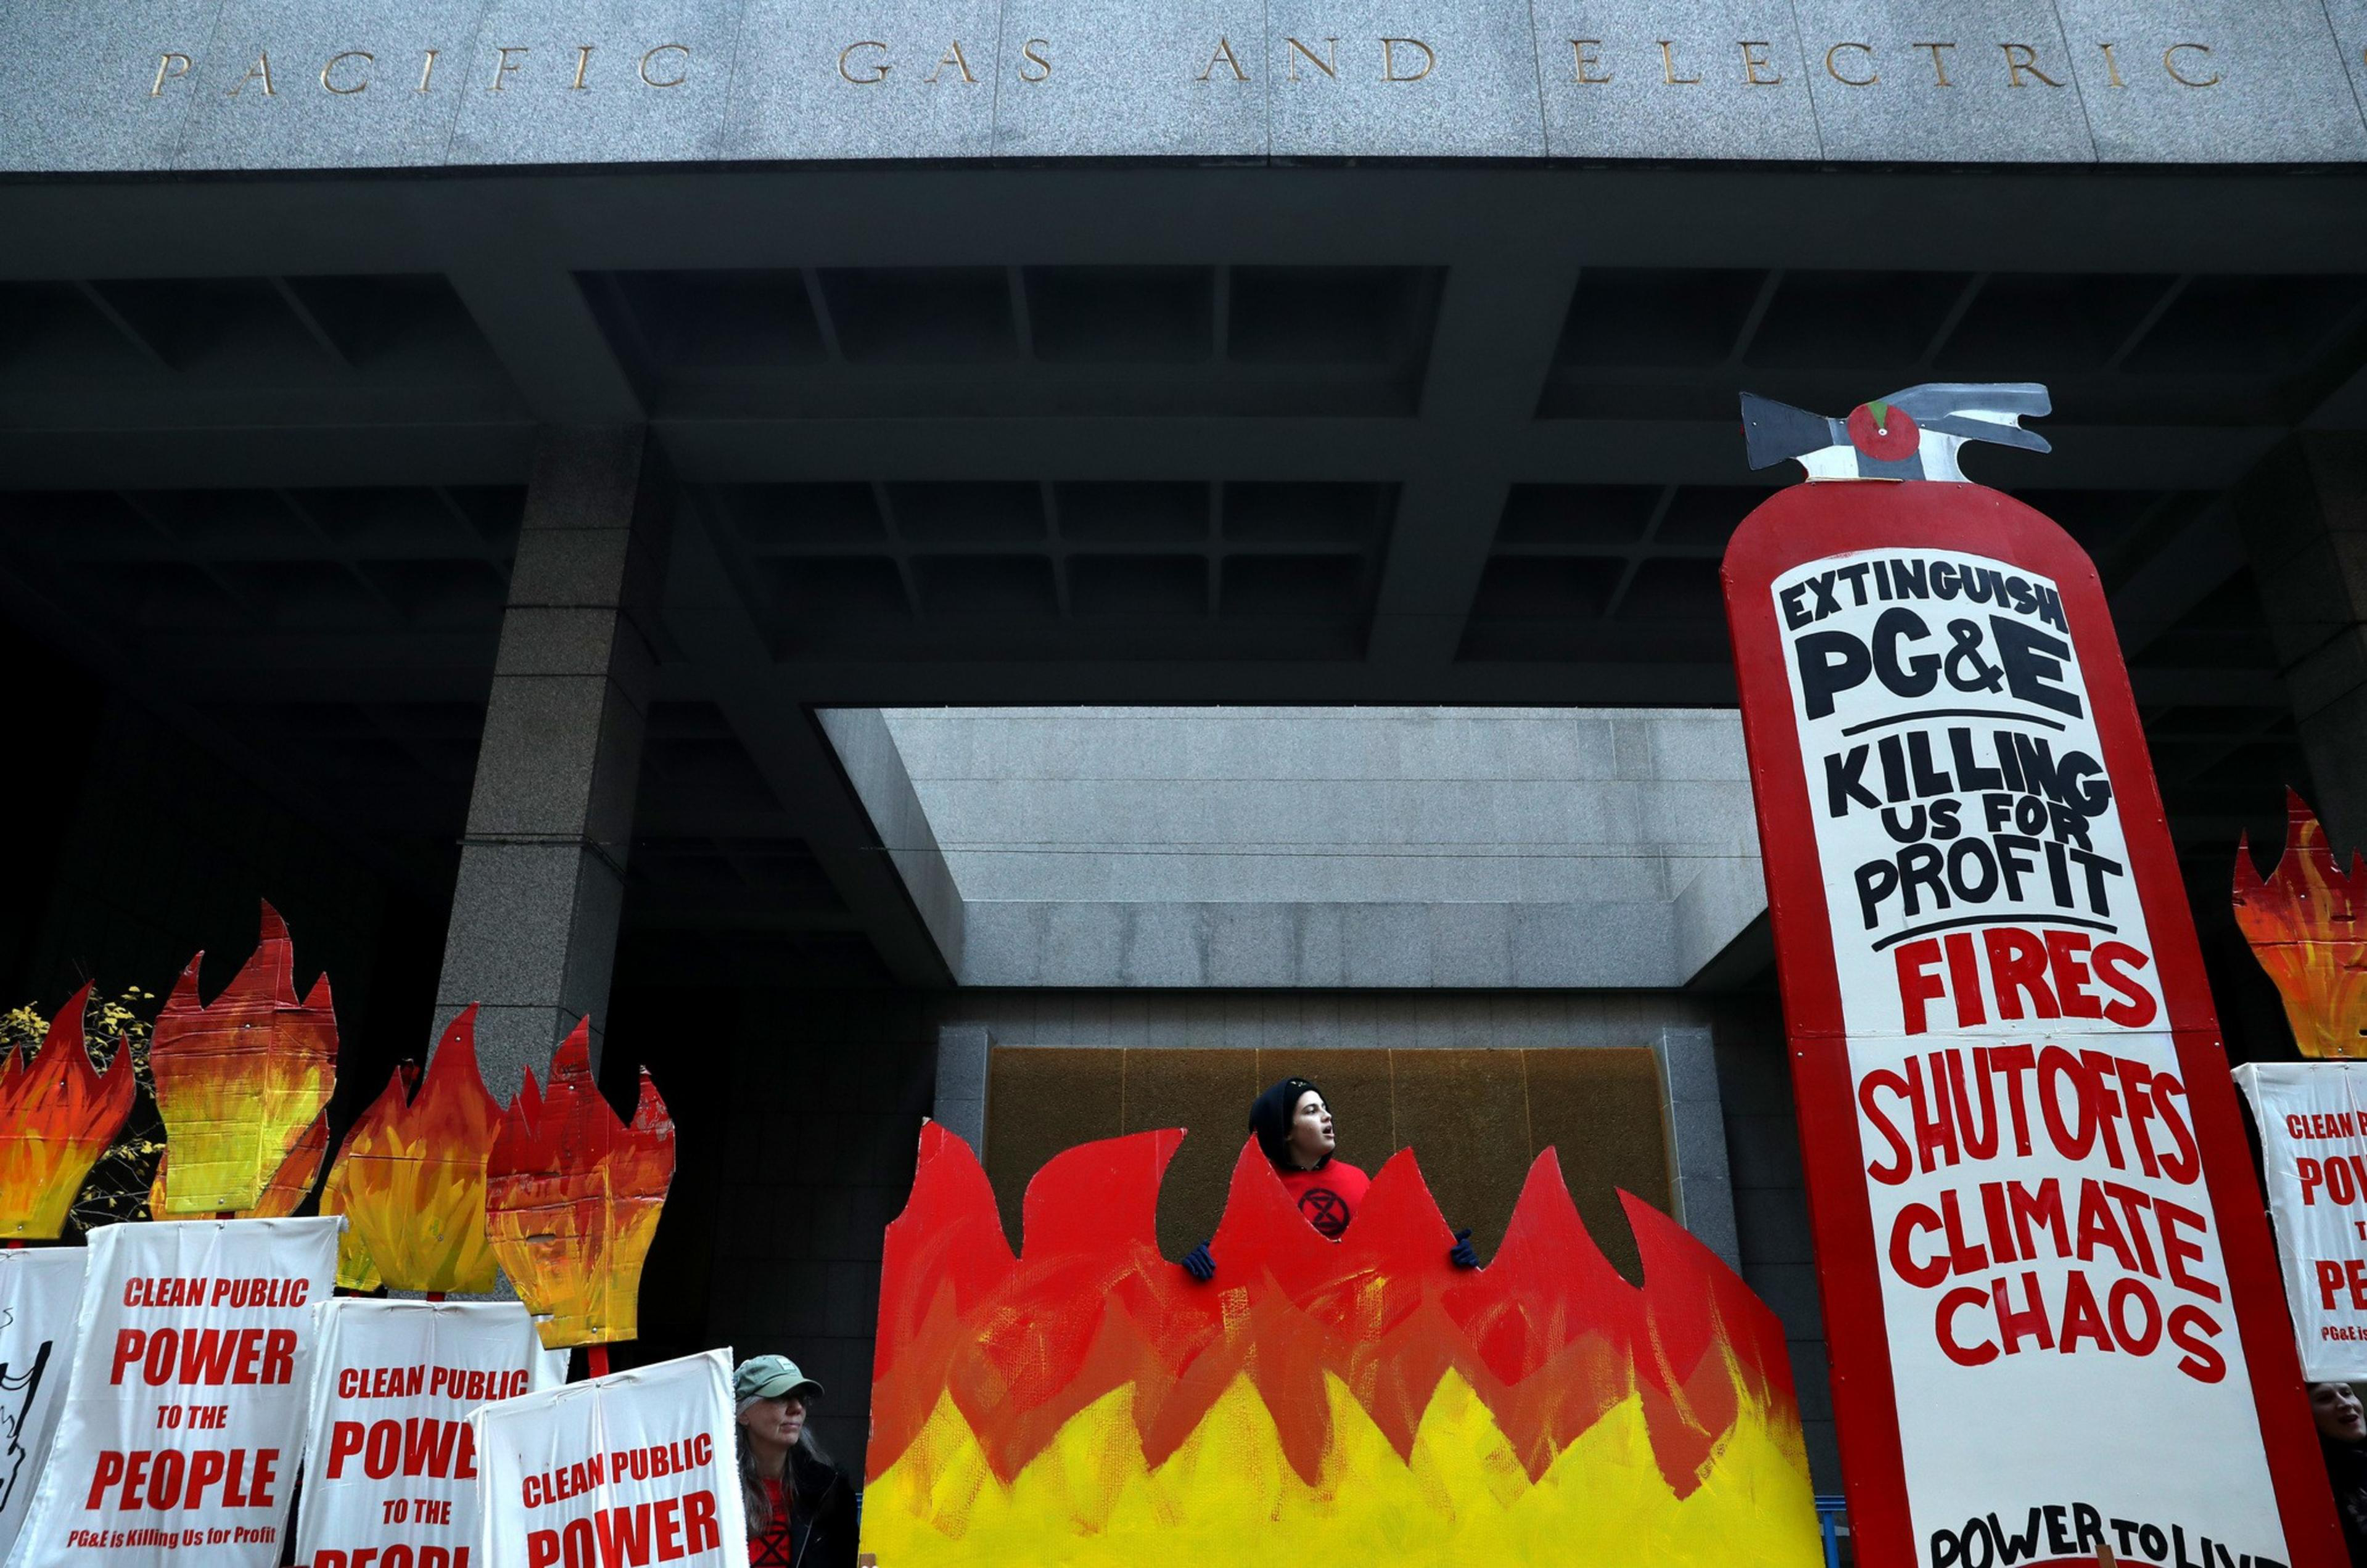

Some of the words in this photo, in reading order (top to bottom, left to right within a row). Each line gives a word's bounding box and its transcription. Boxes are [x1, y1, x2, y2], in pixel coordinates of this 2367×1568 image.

[148, 43, 690, 96] PACIFIC
[837, 38, 1052, 83] GAS
[1195, 37, 1437, 81] AND
[1570, 39, 2220, 88] ELECTRIC
[1779, 559, 2070, 635] EXTINGUISH
[1794, 607, 2083, 720] PG&E
[1823, 727, 2113, 818] KILLING
[1880, 798, 1962, 844] US
[1982, 793, 2093, 853] FOR
[1854, 834, 2124, 930] PROFIT
[1893, 927, 2158, 1036] FIRES
[1858, 1044, 2200, 1186] SHUTOFFS
[2286, 1112, 2355, 1139] CLEAN
[1888, 1178, 2223, 1303] CLIMATE
[123, 1277, 208, 1308] CLEAN
[210, 1278, 310, 1309] PUBLIC
[110, 1328, 298, 1387] POWER
[1935, 1270, 2227, 1384] CHAOS
[2323, 1326, 2355, 1340] PG&E
[338, 1364, 425, 1400] CLEAN
[429, 1366, 529, 1401] PUBLIC
[157, 1404, 183, 1430] TO
[187, 1405, 228, 1430] THE
[86, 1449, 280, 1512] PEOPLE
[522, 1452, 605, 1510] CLEAN
[611, 1433, 713, 1484] PUBLIC
[68, 1530, 109, 1548] PG&E
[110, 1533, 124, 1548] is
[126, 1529, 178, 1549] Killing
[182, 1530, 203, 1546] Us
[207, 1529, 231, 1545] for
[234, 1526, 276, 1543] Profit
[384, 1498, 409, 1525] TO
[414, 1498, 451, 1525] THE
[525, 1488, 721, 1568] POWER
[1930, 1502, 2105, 1568] POWER
[2110, 1518, 2168, 1561] TO
